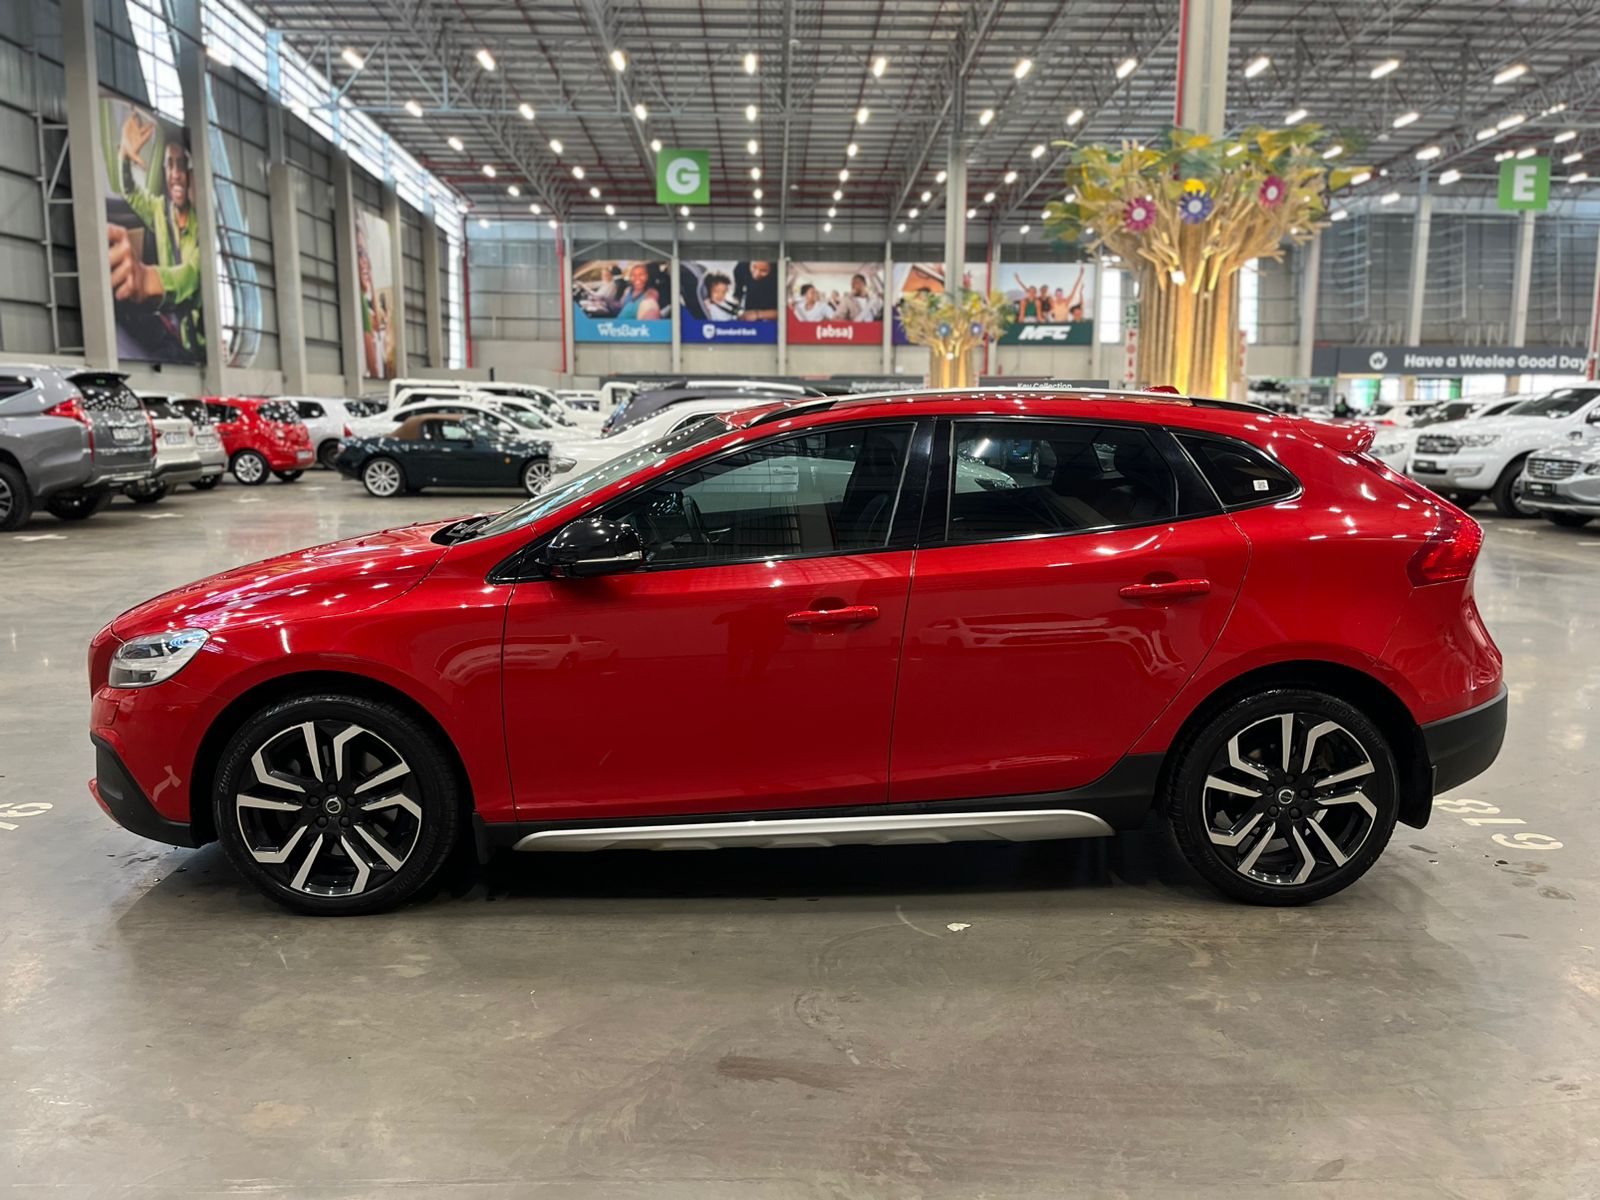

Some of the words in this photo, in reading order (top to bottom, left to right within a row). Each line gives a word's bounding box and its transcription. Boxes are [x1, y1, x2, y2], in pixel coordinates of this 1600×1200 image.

[666, 157, 701, 196] G
[1511, 165, 1537, 202] E
[597, 322, 651, 338] WesBank
[1018, 325, 1072, 341] MFC
[1403, 354, 1444, 368] Have
[1446, 356, 1458, 368] a
[1459, 354, 1516, 368] Weelee
[1517, 354, 1558, 368] Good
[1559, 354, 1587, 373] Day
